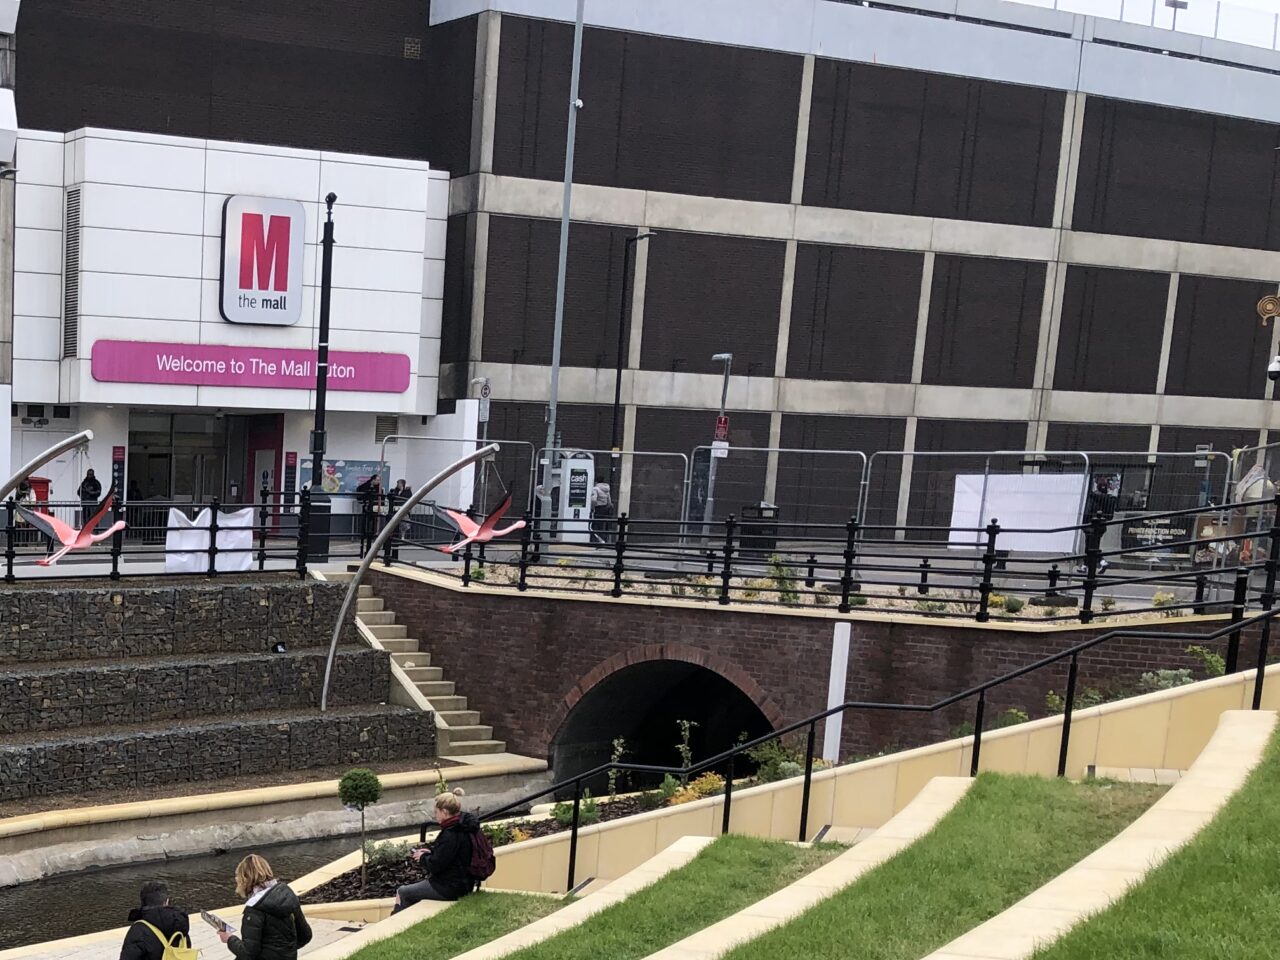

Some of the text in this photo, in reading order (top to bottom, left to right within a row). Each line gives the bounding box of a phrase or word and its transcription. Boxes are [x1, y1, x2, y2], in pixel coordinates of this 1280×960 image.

[238, 212, 291, 292] M
[238, 293, 287, 310] the mall
[156, 354, 226, 374] Welcome
[230, 359, 245, 374] to
[249, 358, 276, 375] The
[281, 360, 311, 377] Mall
[570, 474, 587, 482] cash
